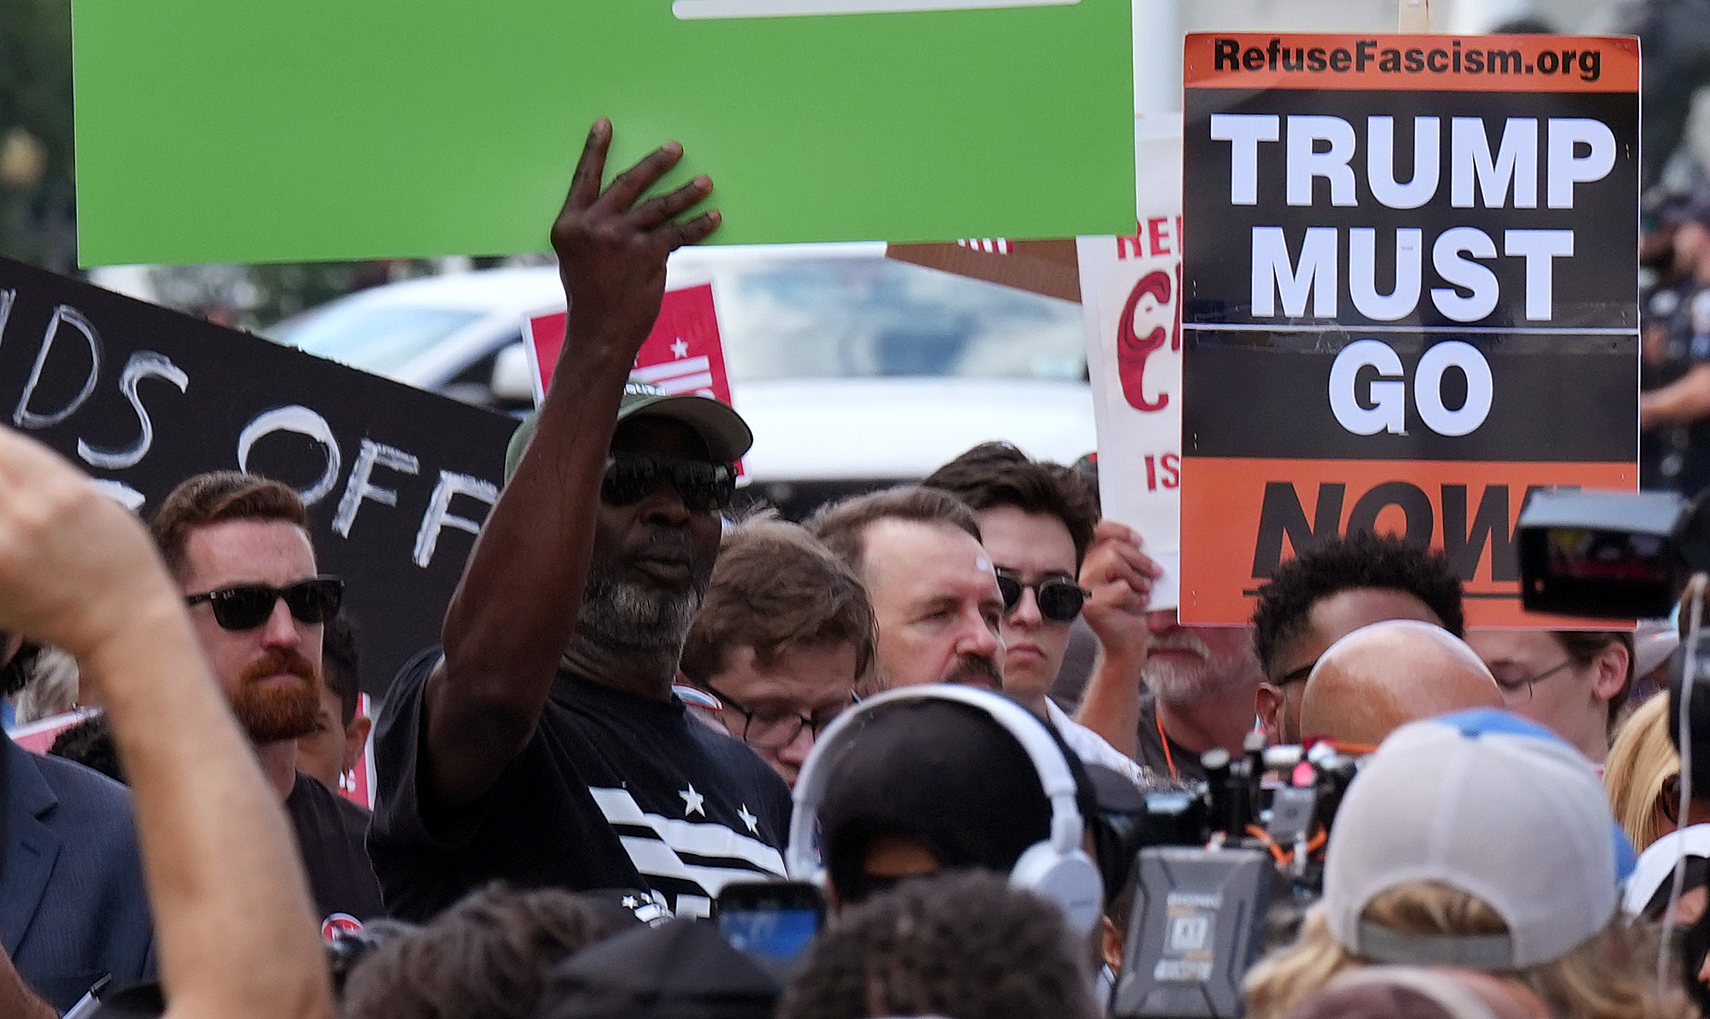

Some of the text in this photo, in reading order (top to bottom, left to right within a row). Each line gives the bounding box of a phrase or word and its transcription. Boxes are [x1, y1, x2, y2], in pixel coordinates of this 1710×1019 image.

[1213, 38, 1602, 79] RefuseFascism.org
[1210, 114, 1617, 209] TRUMP
[1251, 226, 1575, 322] MUST
[1328, 341, 1494, 437] GO
[238, 404, 498, 568] OFF
